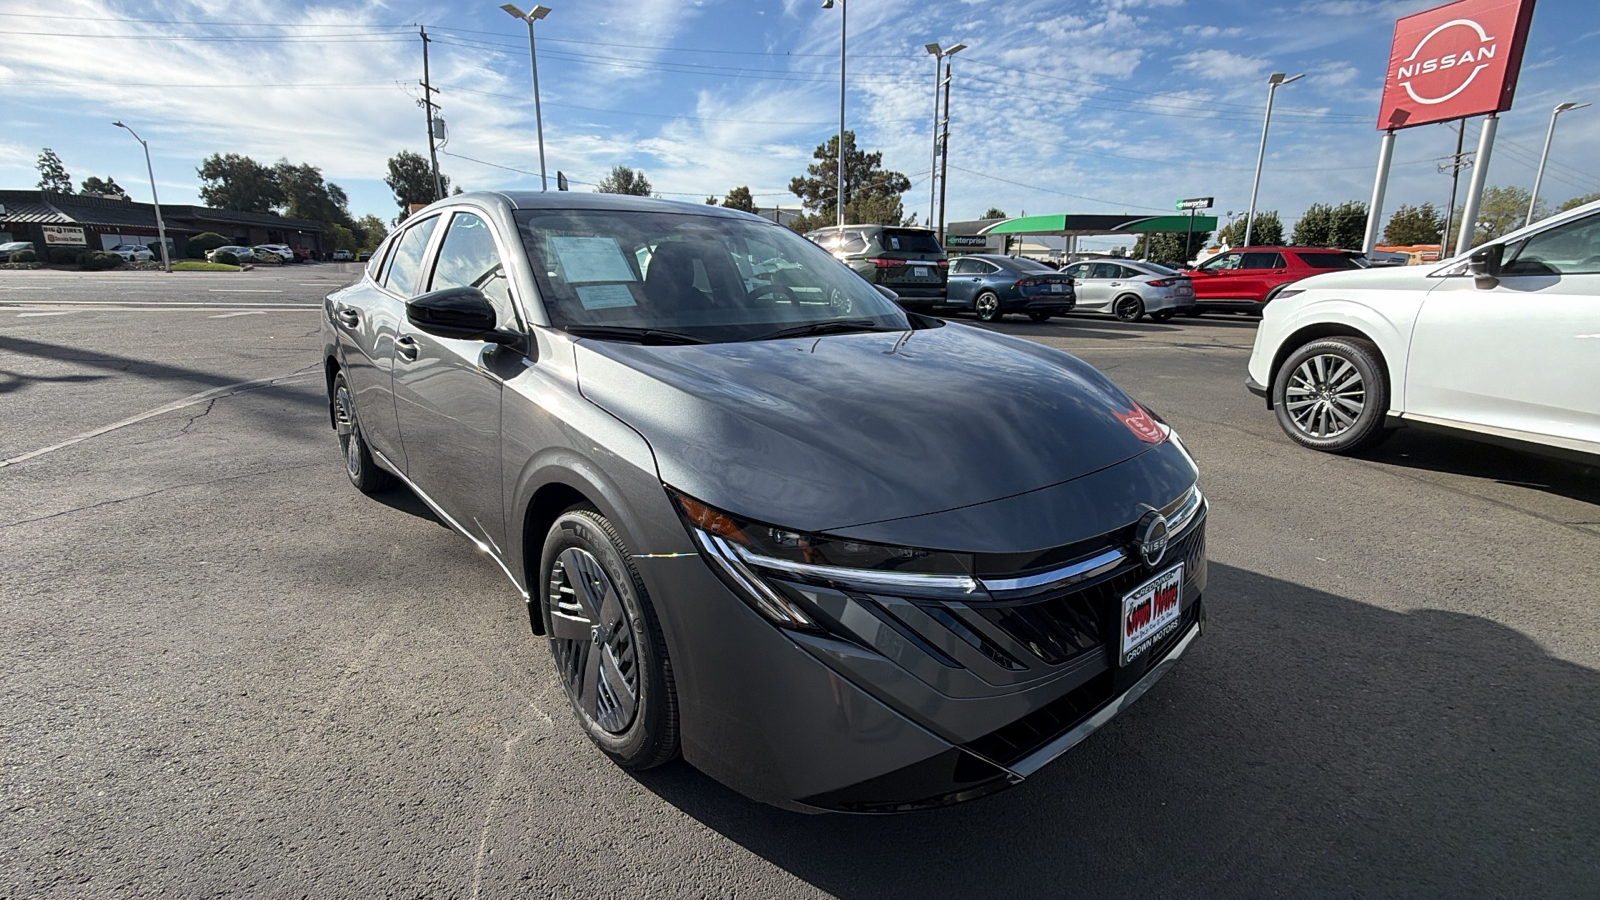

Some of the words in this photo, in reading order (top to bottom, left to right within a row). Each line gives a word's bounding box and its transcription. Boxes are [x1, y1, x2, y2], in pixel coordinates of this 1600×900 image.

[1397, 44, 1496, 79] NISSAN
[948, 236, 986, 245] enterprise
[1141, 539, 1168, 554] NISS
[1139, 572, 1173, 596] REDDING
[1126, 638, 1152, 663] CROWN
[1152, 619, 1179, 644] MOTORS
